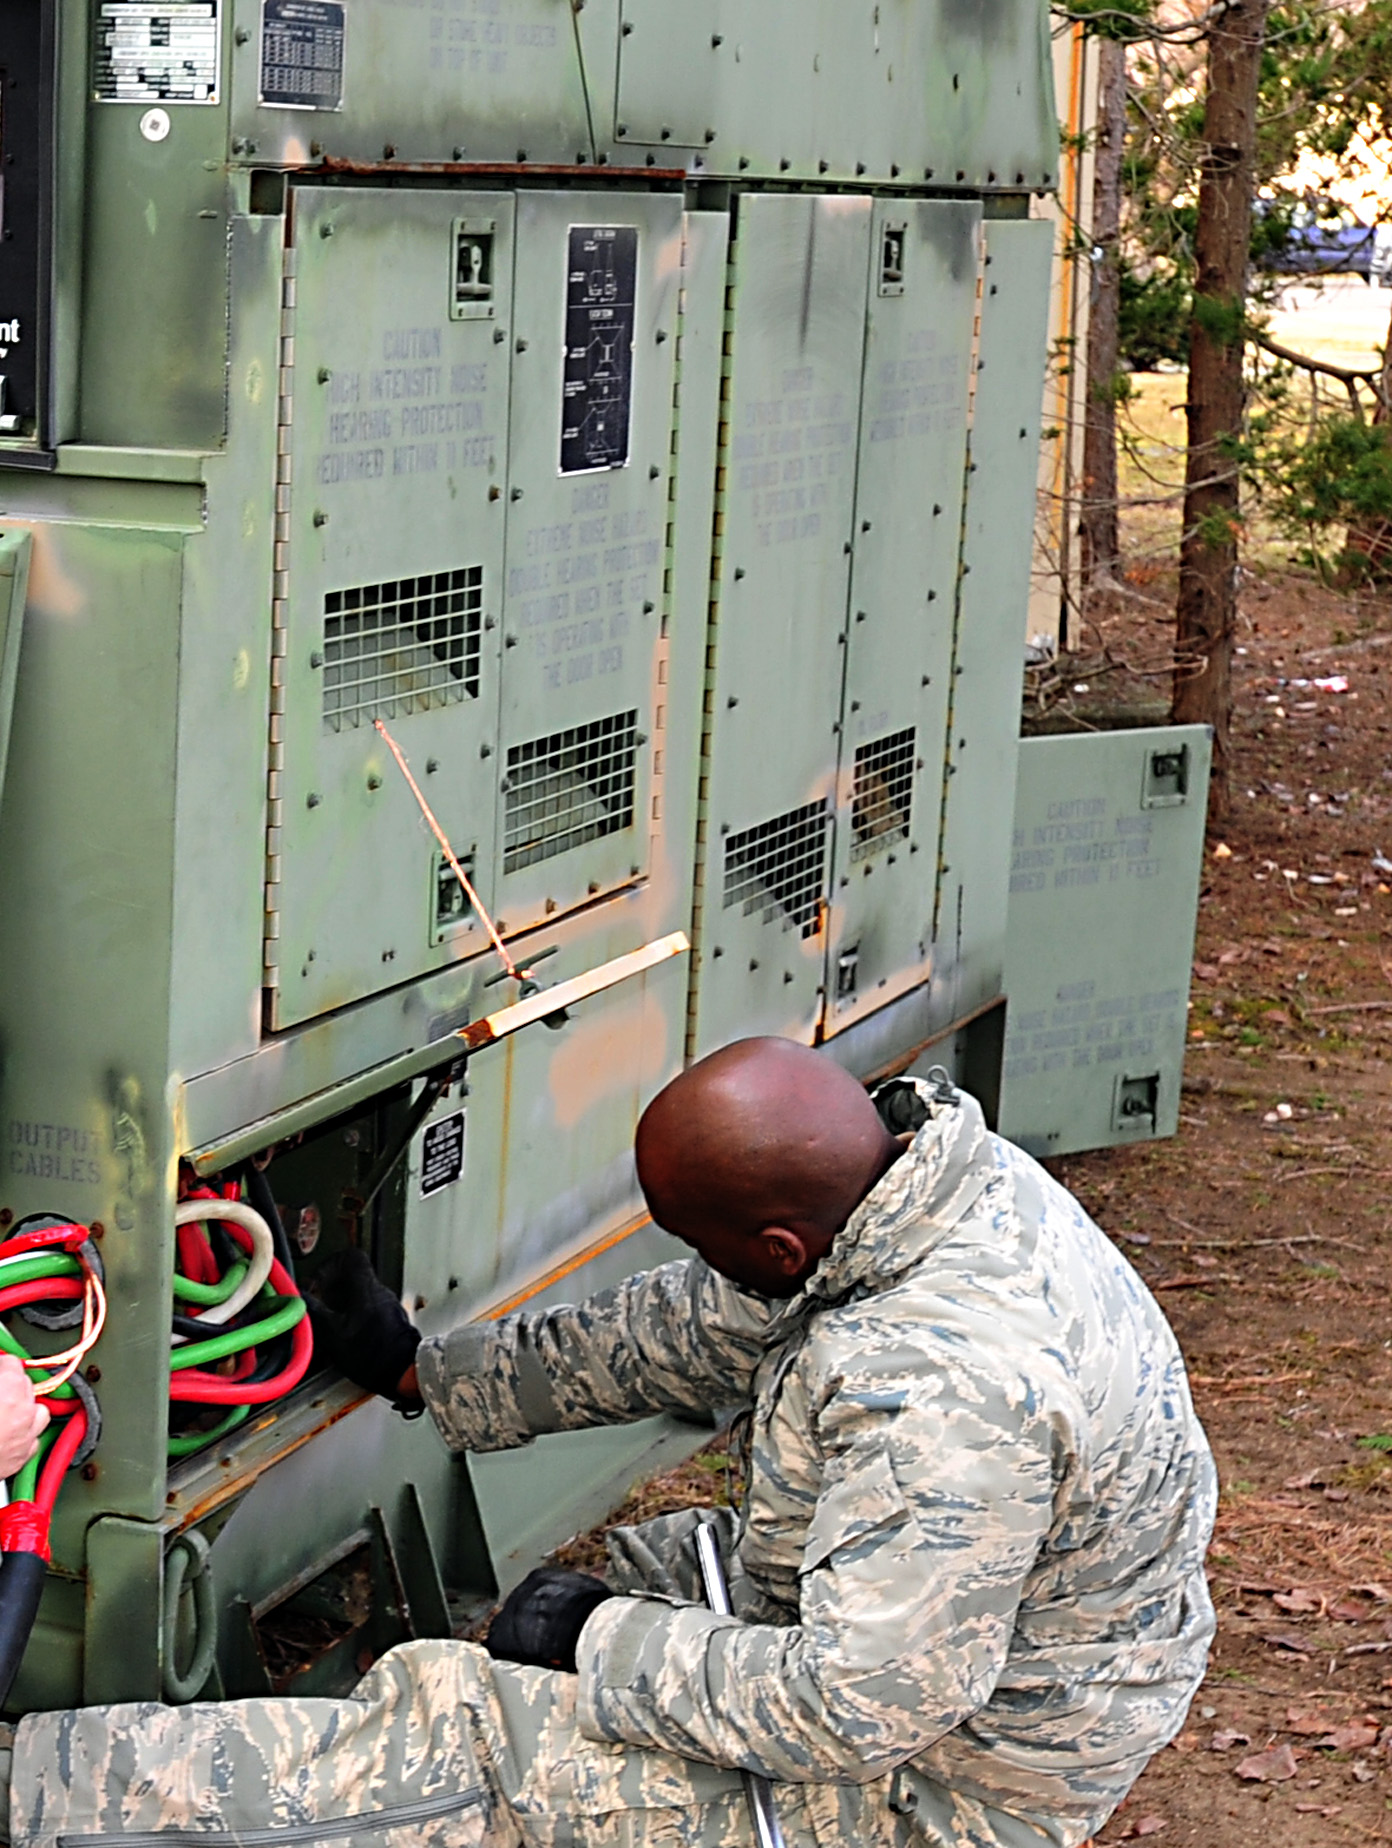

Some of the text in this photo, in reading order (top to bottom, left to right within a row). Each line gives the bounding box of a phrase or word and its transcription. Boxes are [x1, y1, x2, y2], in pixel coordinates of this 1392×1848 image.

[383, 328, 441, 361] CAUTION
[370, 366, 441, 400] INTENSITY
[330, 401, 483, 444] HEARING PROTECTION
[462, 435, 495, 468] FEET
[10, 1120, 100, 1152] OUTPUT
[10, 1150, 102, 1184] CABLES
